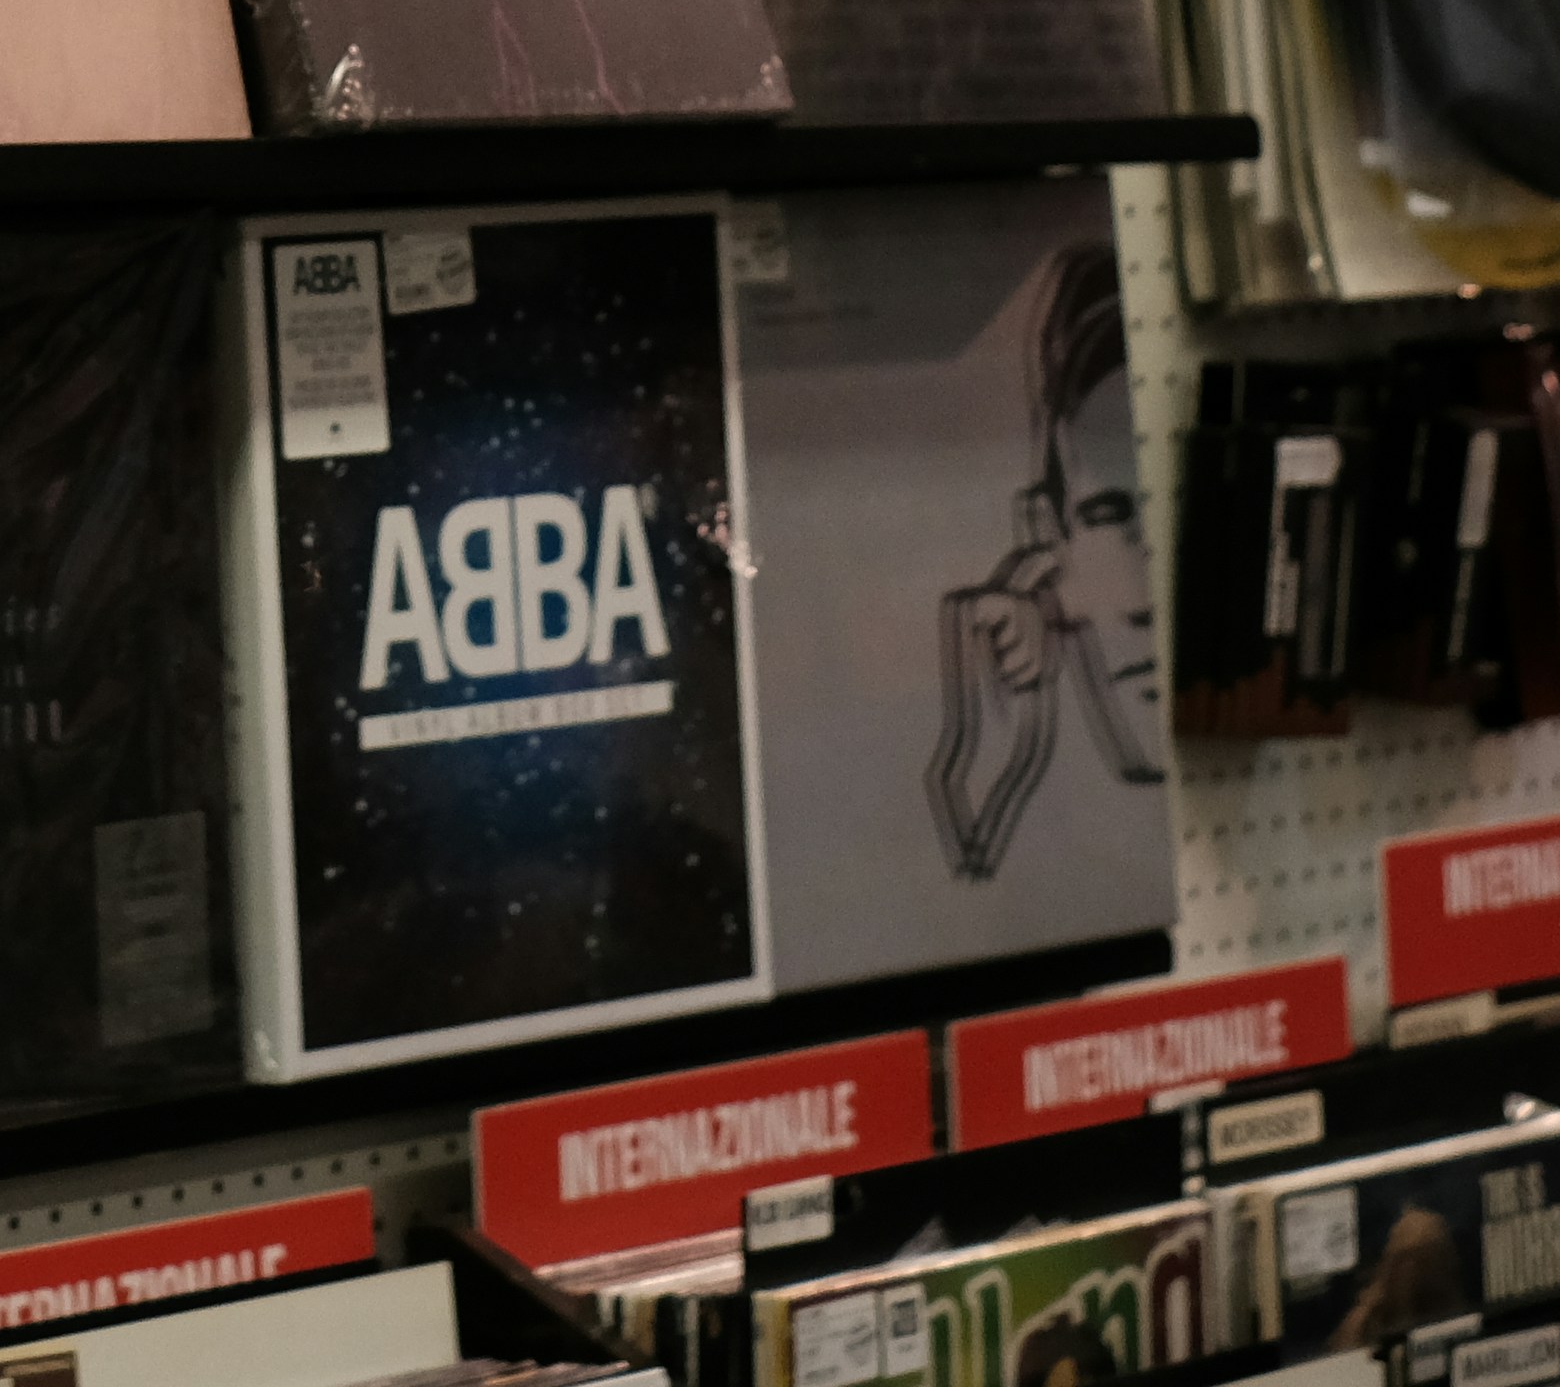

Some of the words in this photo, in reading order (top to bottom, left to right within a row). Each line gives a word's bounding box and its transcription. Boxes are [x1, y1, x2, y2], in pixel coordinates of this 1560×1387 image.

[293, 252, 361, 296] ABBA
[358, 483, 672, 692] ABBA
[1024, 1000, 1289, 1112] INTERNAZIONALE
[558, 1080, 860, 1204] INTERNAZIONALE
